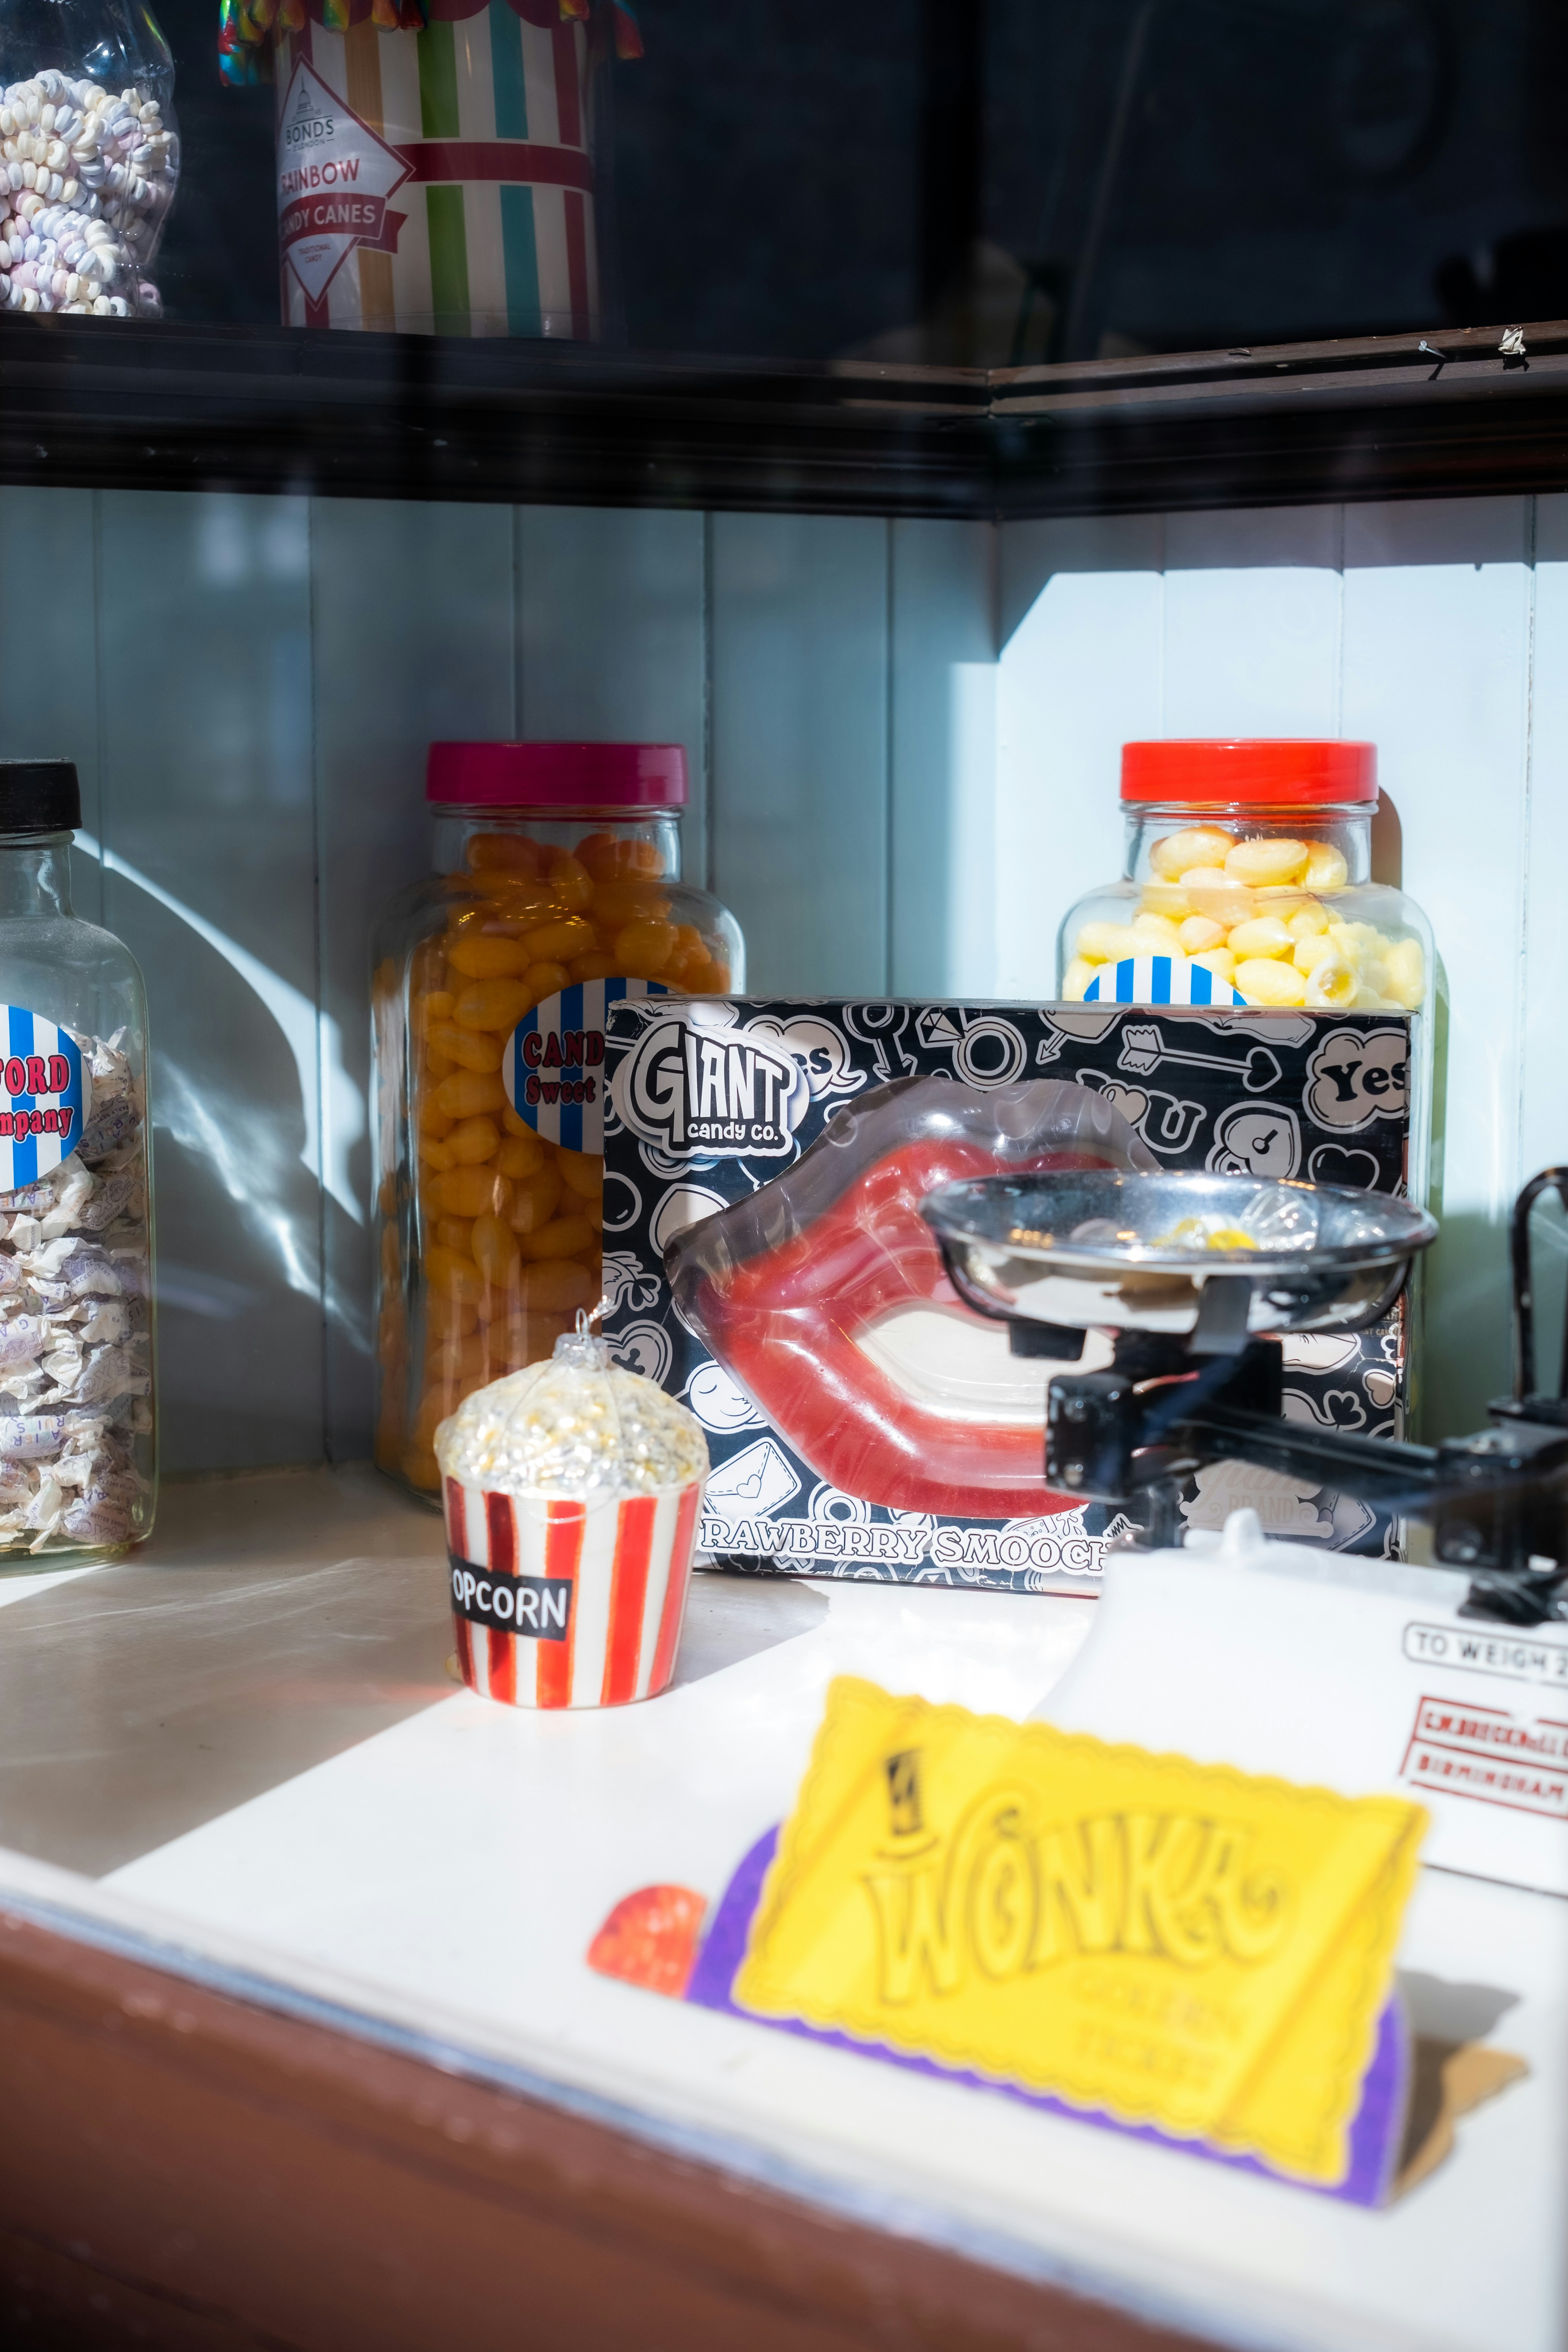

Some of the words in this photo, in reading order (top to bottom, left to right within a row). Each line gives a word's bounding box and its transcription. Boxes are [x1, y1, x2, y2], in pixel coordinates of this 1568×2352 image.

[286, 119, 334, 146] BONDS
[282, 158, 359, 195] RAINBOW
[314, 204, 376, 225] CANES
[0, 1054, 70, 1096] ORD
[526, 1075, 596, 1106] Sweet
[634, 1019, 782, 1142] GIANT
[1320, 1060, 1405, 1102] Yes
[686, 1122, 747, 1140] candy
[750, 1124, 779, 1141] co.
[701, 1518, 927, 1559] RAWBERRY
[935, 1530, 1112, 1571] SMOOCH
[453, 1568, 568, 1629] OPCORN
[1416, 1631, 1448, 1656] TO
[1458, 1638, 1546, 1673] WEIGH
[857, 1786, 1289, 2010] WONKA
